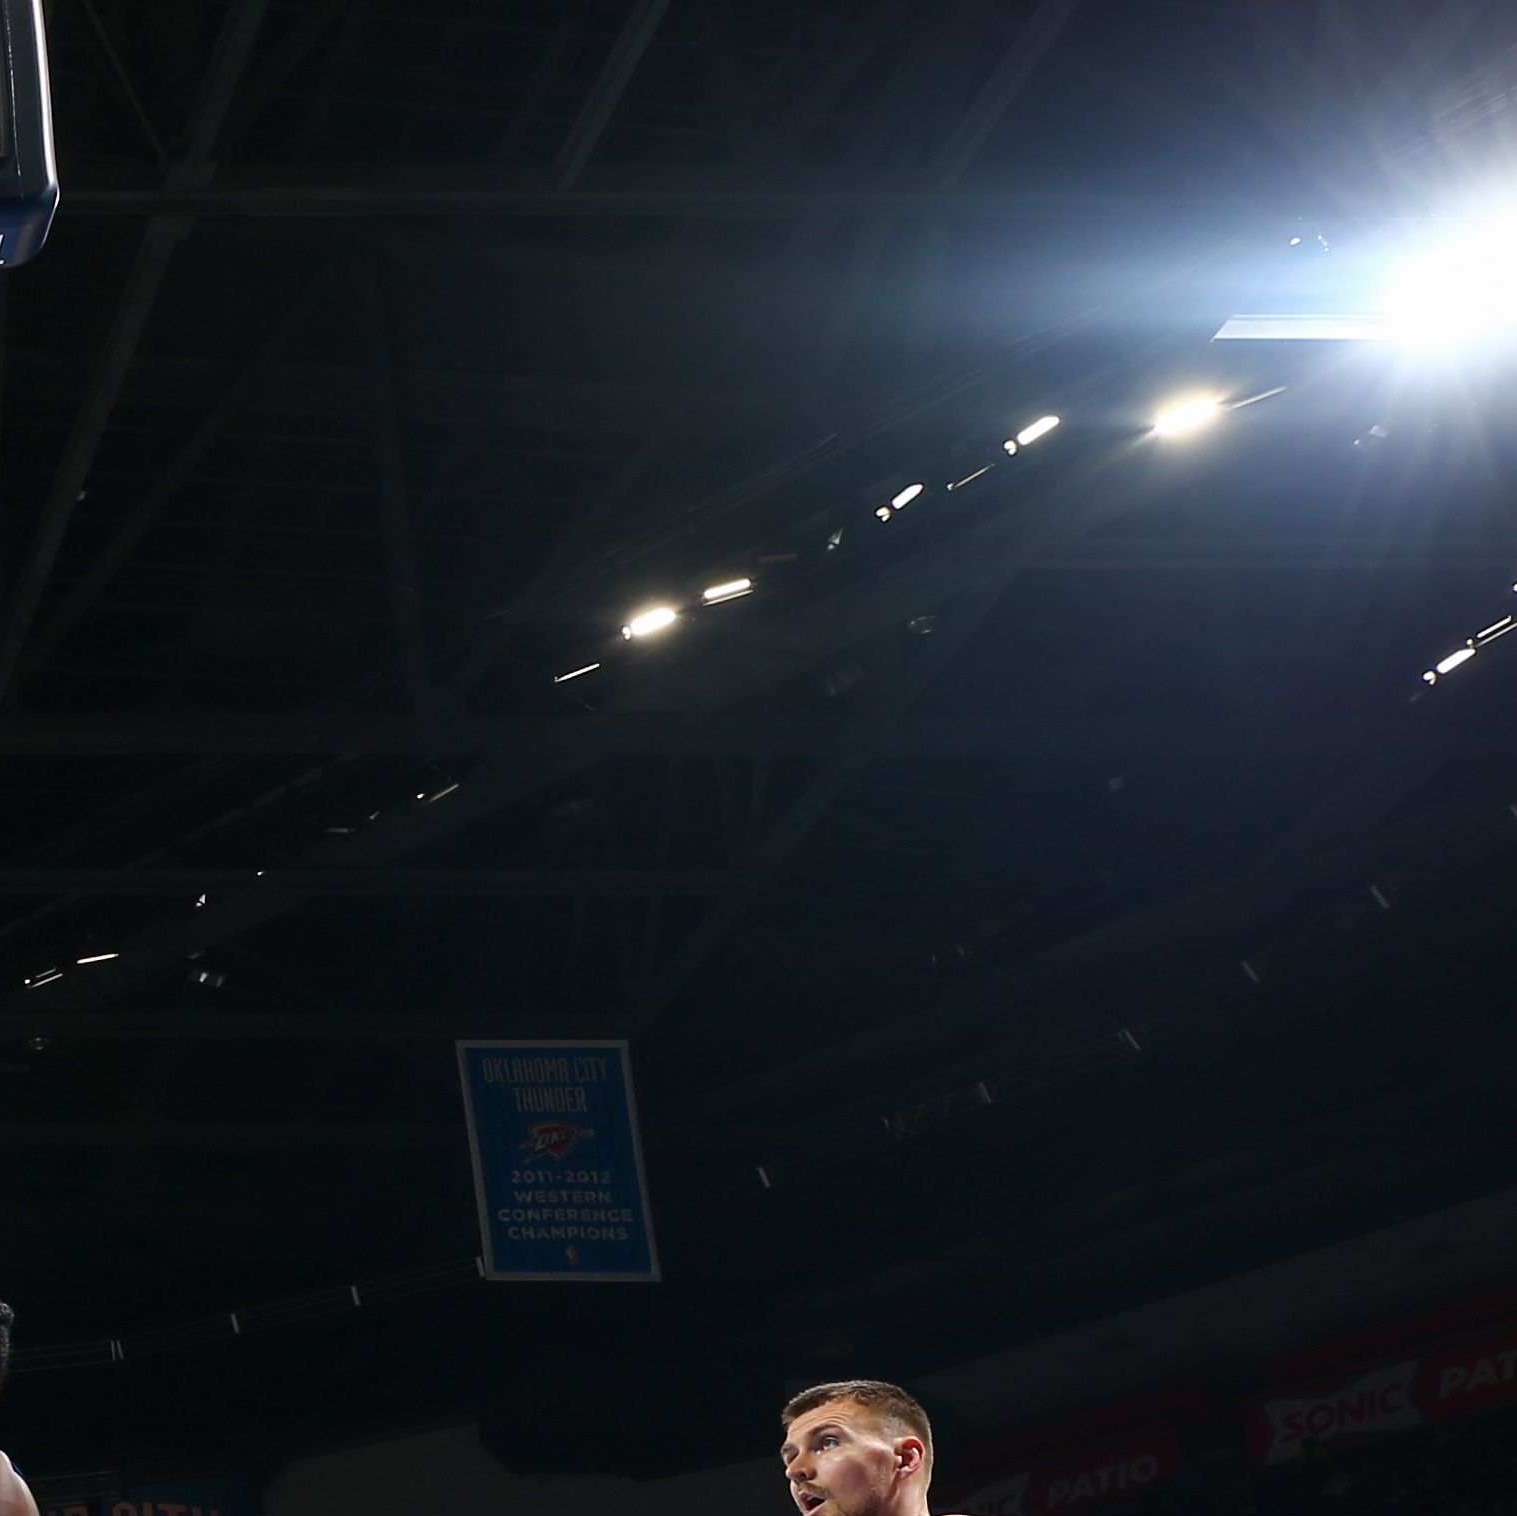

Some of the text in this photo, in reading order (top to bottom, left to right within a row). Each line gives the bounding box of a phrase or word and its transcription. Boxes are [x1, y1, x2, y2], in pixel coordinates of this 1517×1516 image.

[483, 1057, 607, 1083] OKLAHOMA CITY
[513, 1087, 588, 1112] THUNDER
[511, 1170, 612, 1184] 2011-2012
[514, 1191, 611, 1204] WESTERN
[498, 1209, 633, 1222] CONFERENCE
[507, 1227, 627, 1240] CHAMPIONS
[1280, 1382, 1403, 1444] SONIC
[1046, 1454, 1160, 1510] PATIO
